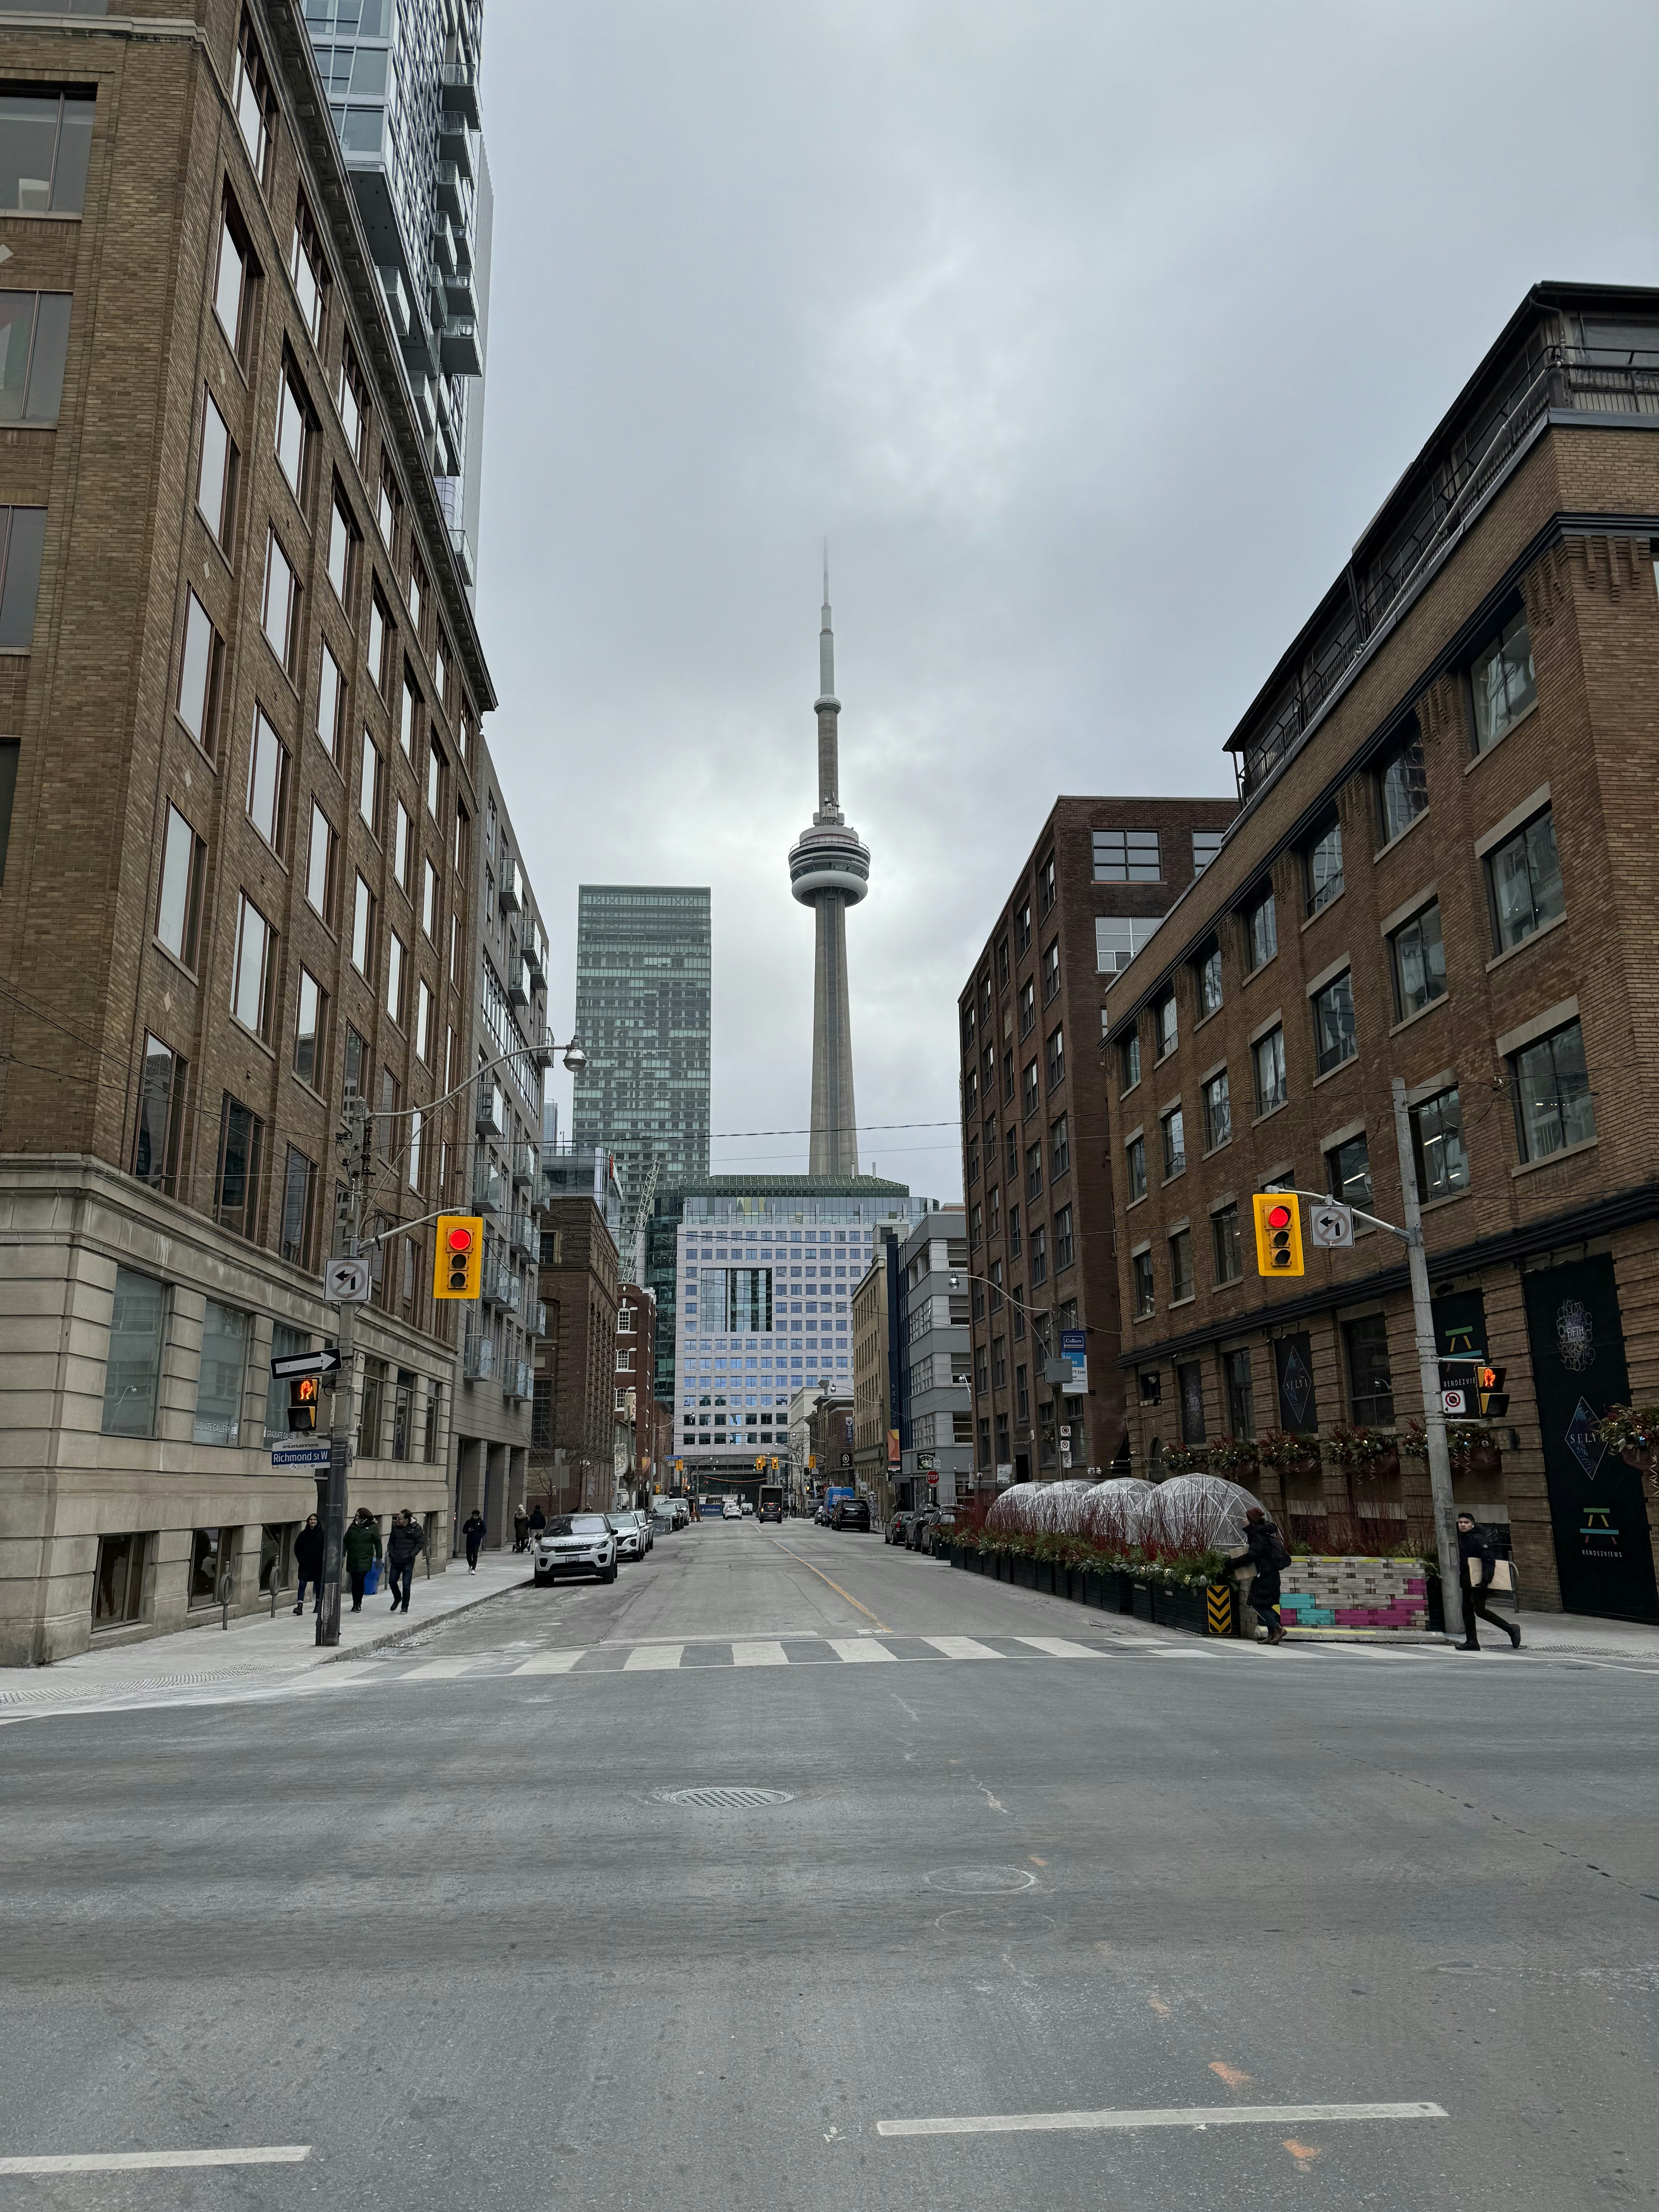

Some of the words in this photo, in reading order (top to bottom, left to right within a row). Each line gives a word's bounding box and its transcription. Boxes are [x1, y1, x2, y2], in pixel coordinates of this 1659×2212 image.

[1567, 1326, 1584, 1337] FIFTH
[1444, 1377, 1475, 1387] RENDEZVIE
[195, 1421, 212, 1431] RADUATE
[267, 1431, 283, 1439] GRADUATE
[1570, 1433, 1596, 1443] SELV
[274, 1452, 311, 1462] Richmond
[321, 1451, 328, 1460] W
